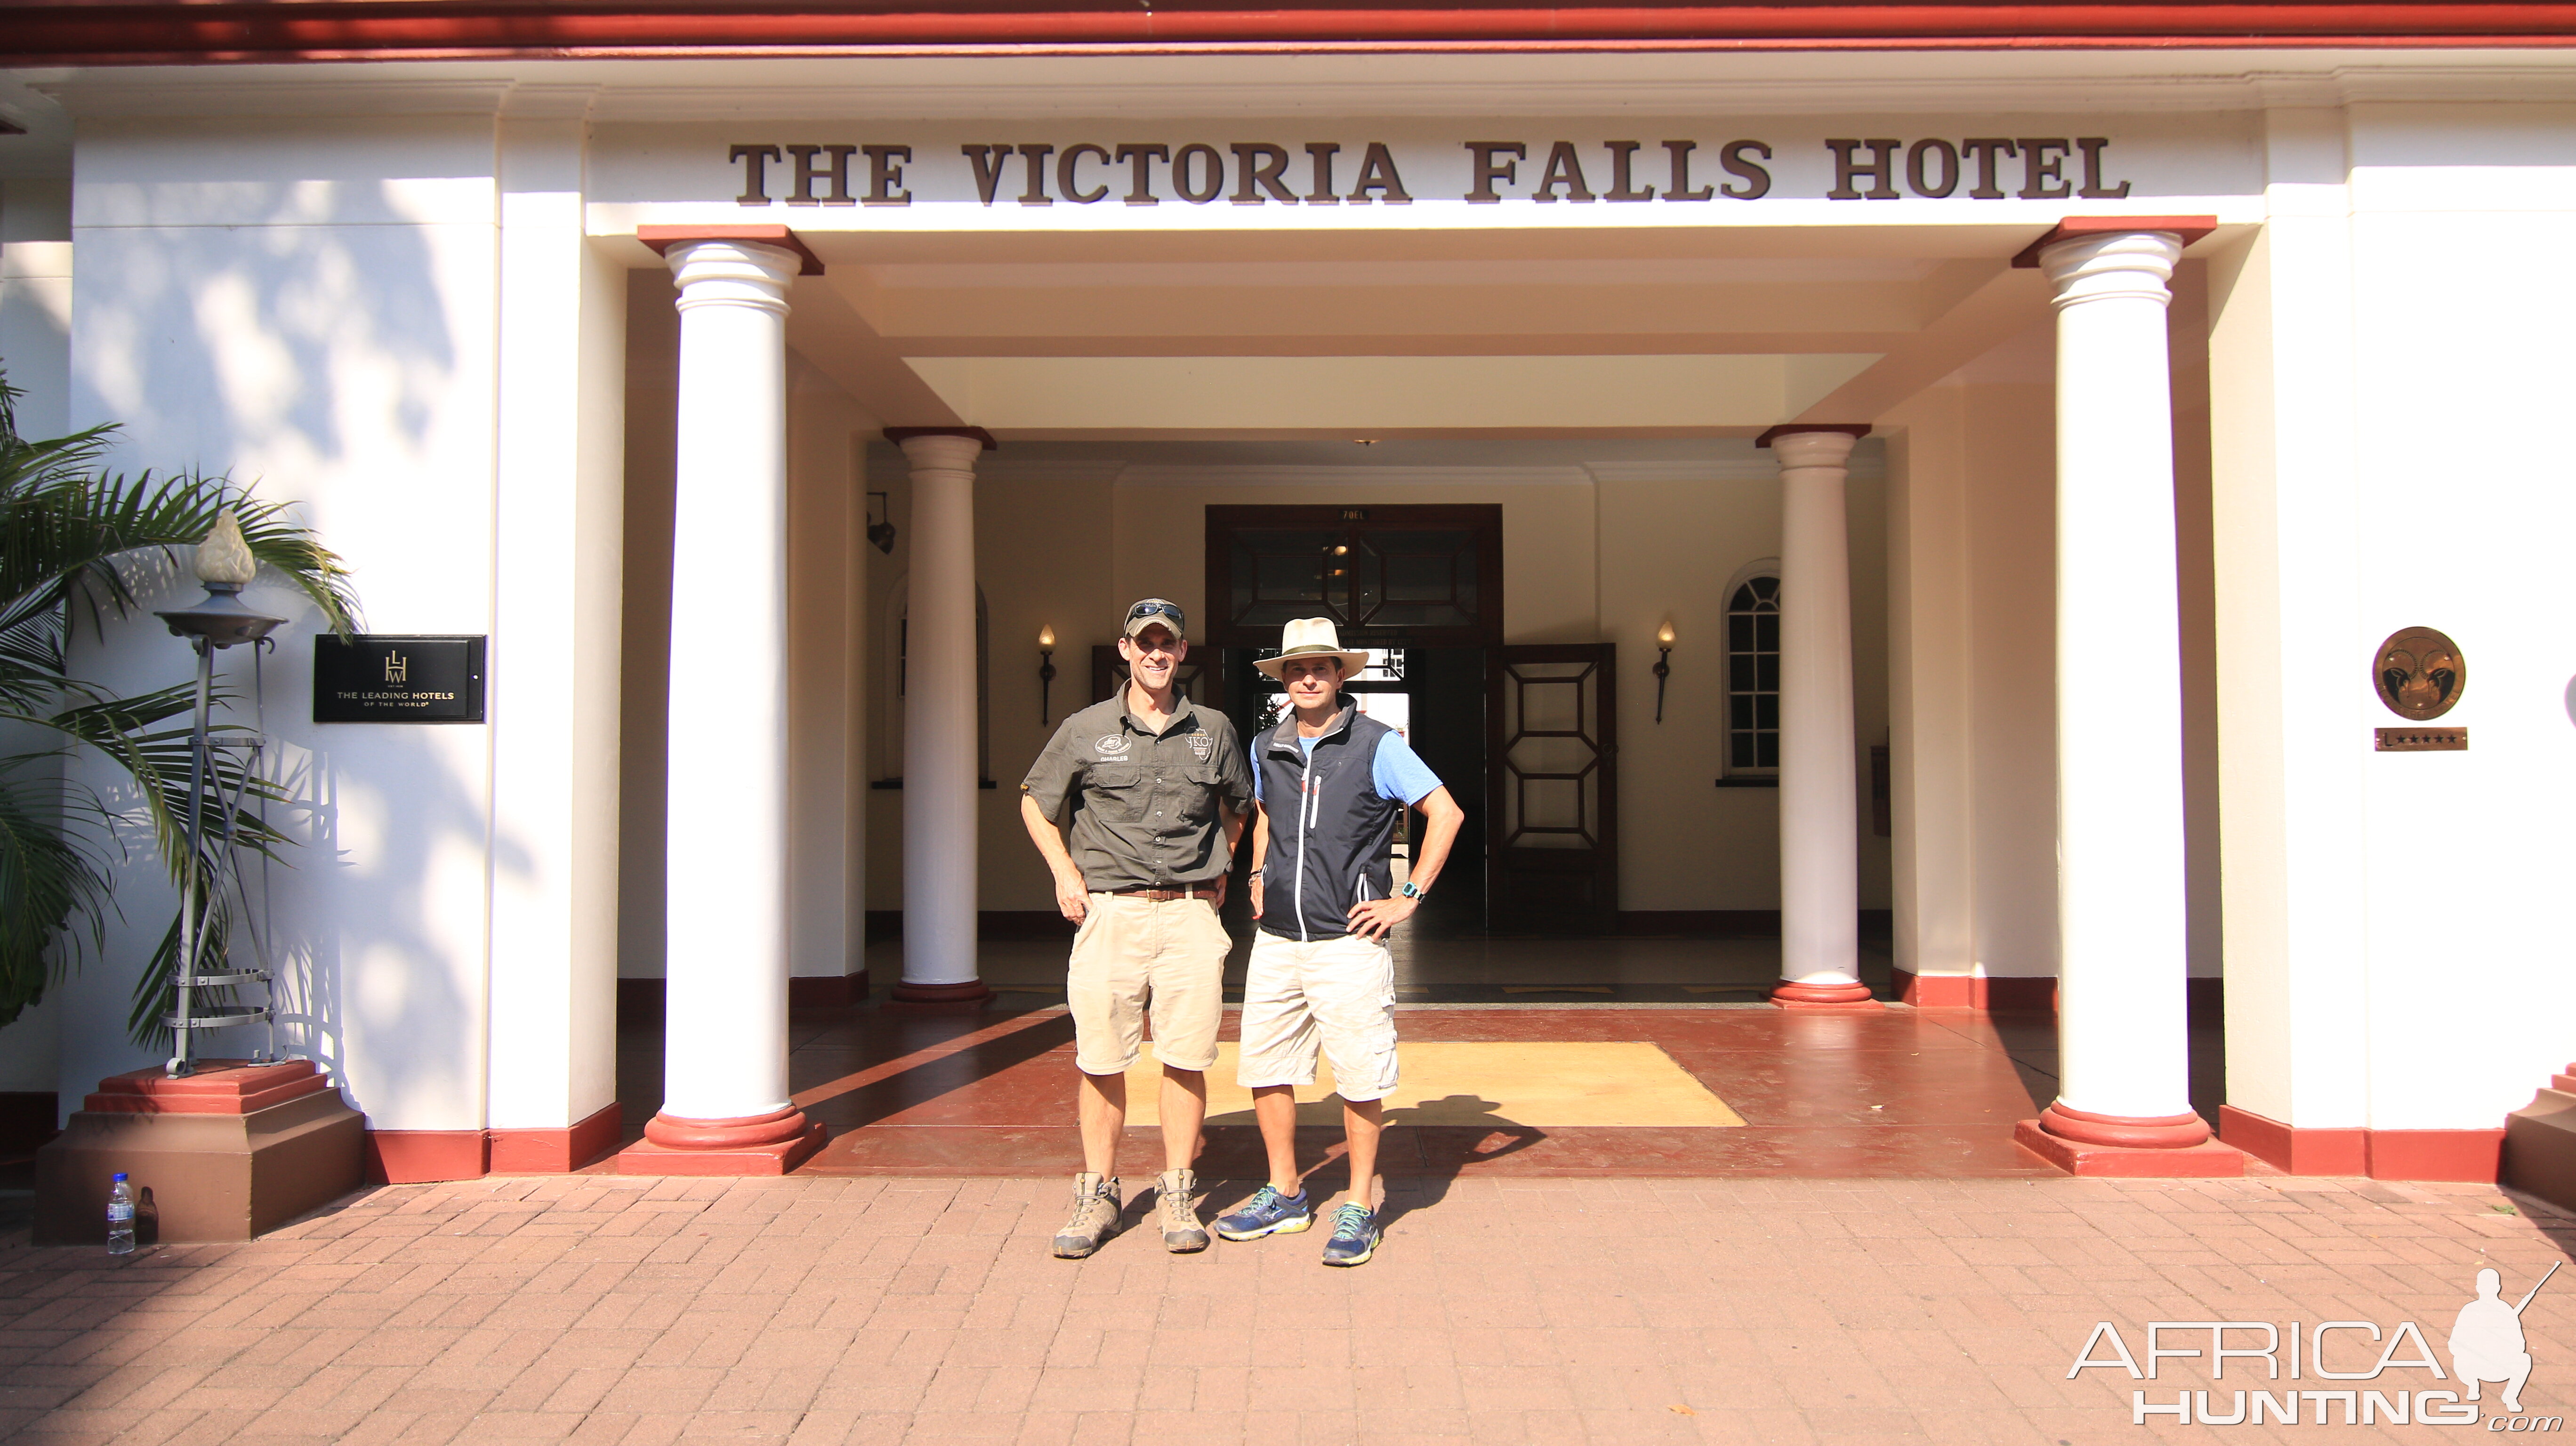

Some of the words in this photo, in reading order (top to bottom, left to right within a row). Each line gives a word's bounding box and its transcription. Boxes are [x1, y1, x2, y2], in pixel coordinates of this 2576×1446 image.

[729, 143, 912, 206] THE
[961, 142, 1414, 206] VICTORIA
[1463, 140, 1772, 203] FALLS
[1825, 137, 2131, 200] HOTEL
[412, 692, 454, 700] HOTELS
